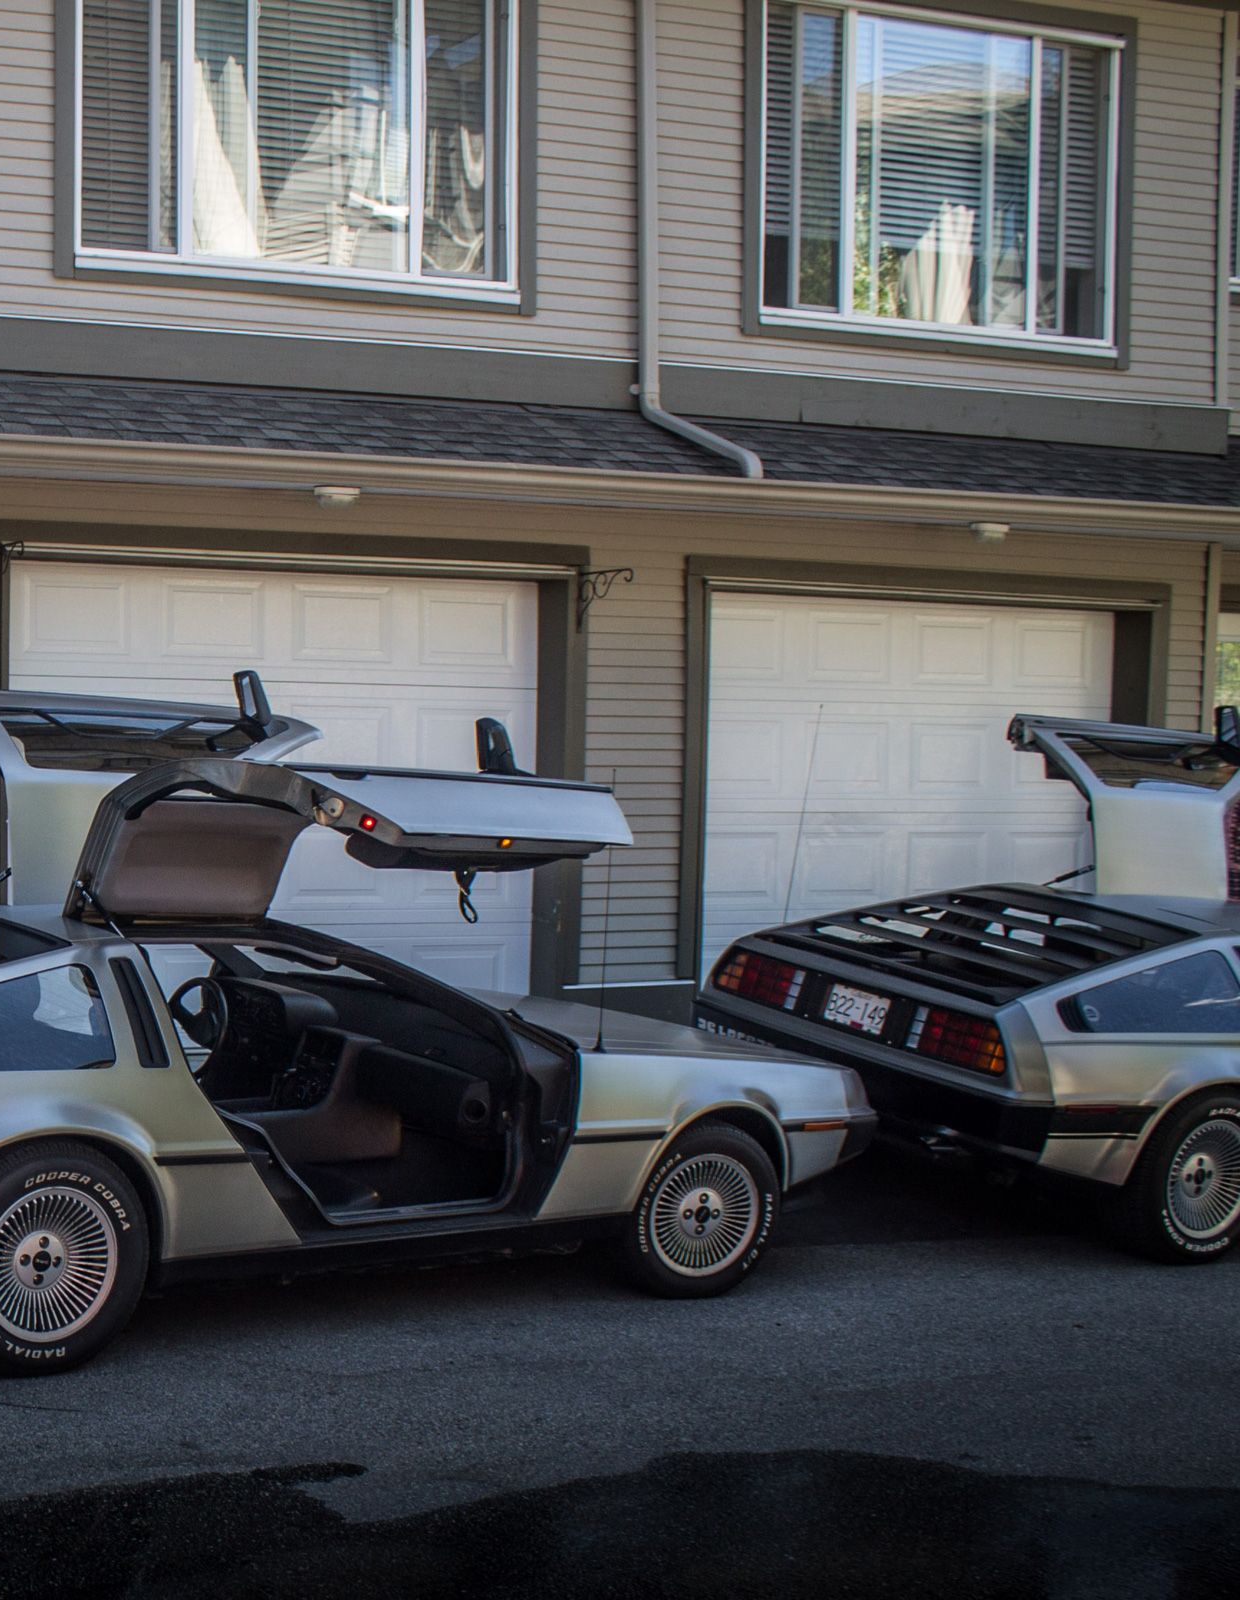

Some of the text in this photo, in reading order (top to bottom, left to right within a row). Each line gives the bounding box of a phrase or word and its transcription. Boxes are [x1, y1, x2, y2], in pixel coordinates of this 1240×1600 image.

[827, 992, 887, 1026] B22-149
[24, 1171, 131, 1231] COOPER COBRA
[5, 1340, 66, 1359] RADIAL
